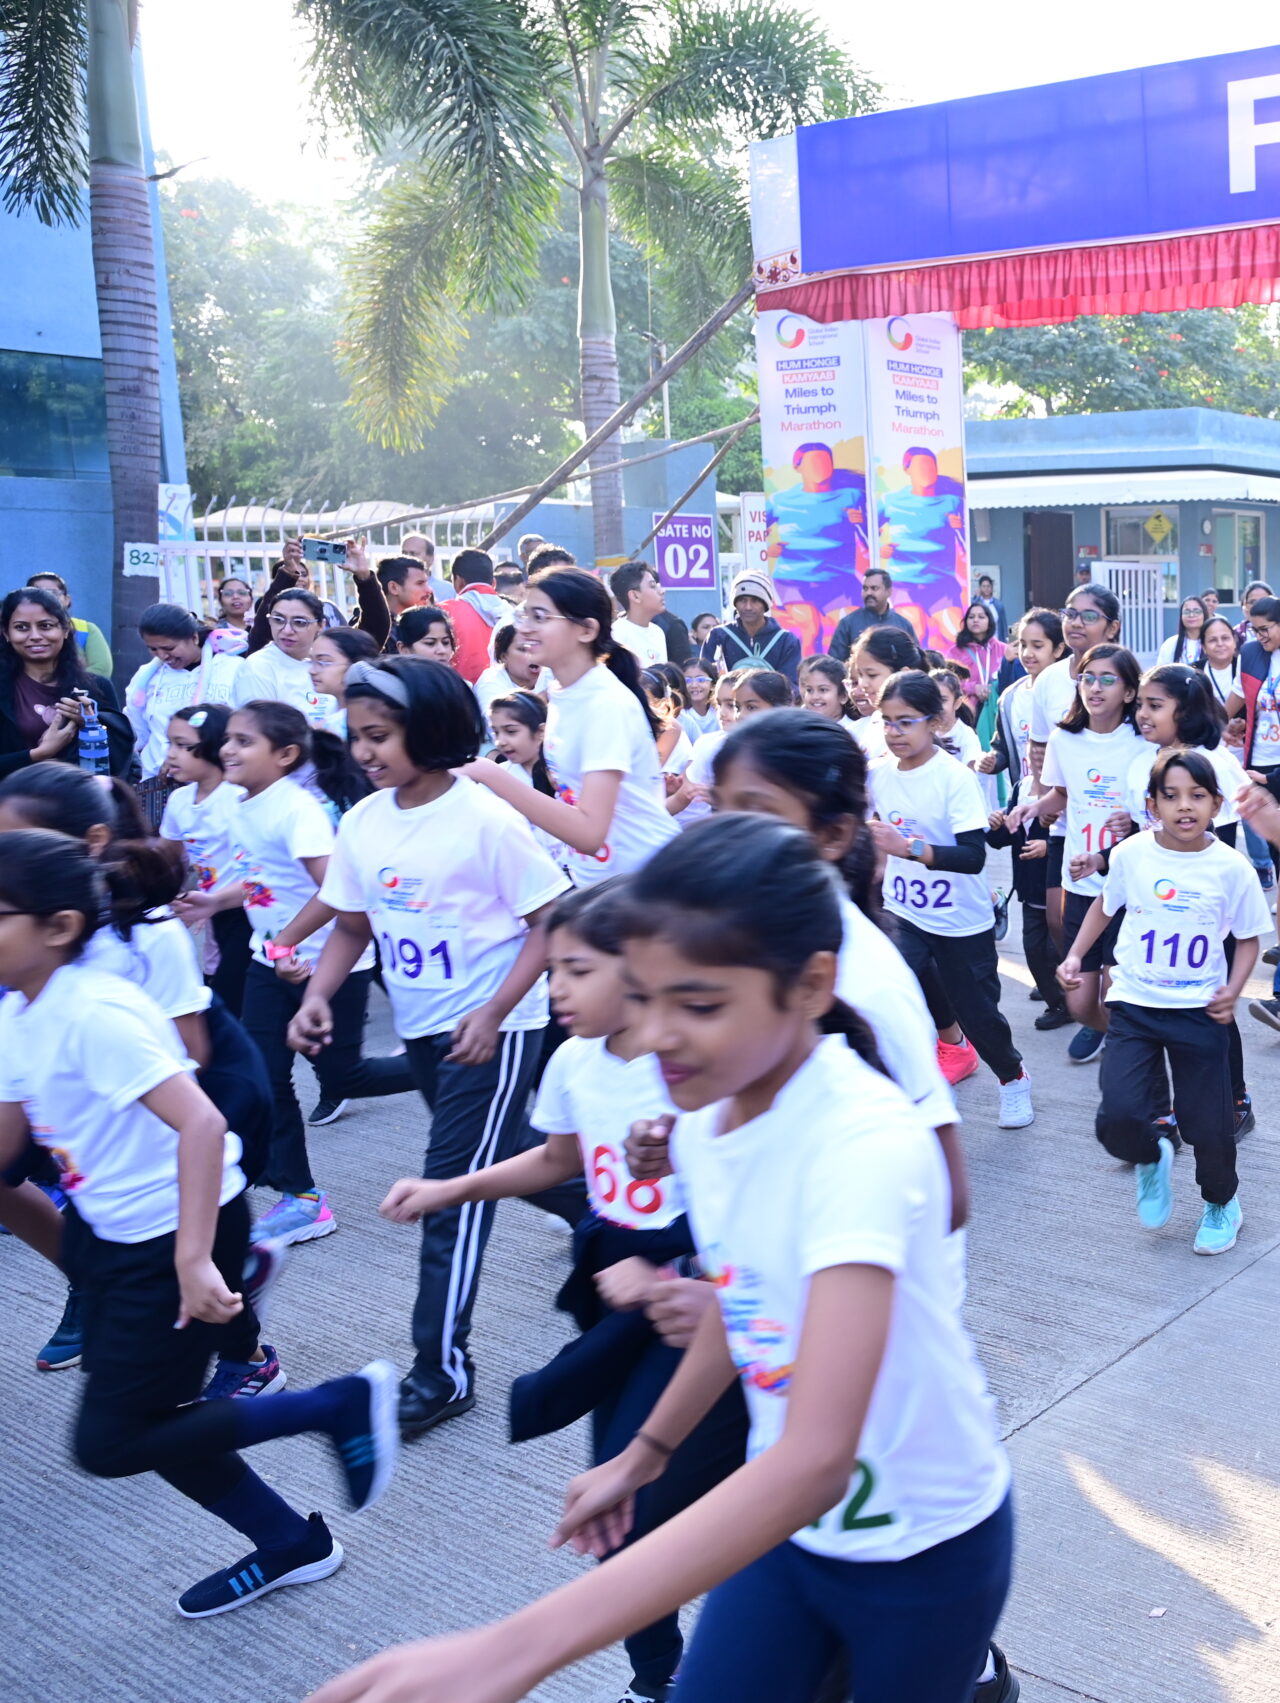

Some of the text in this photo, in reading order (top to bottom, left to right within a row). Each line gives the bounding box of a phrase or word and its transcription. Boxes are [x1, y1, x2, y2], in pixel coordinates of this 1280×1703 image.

[778, 358, 839, 370] HUM HONGE
[888, 360, 940, 377] HUM HONGE
[784, 371, 833, 383] KAMYAAB
[785, 386, 834, 398] Miles to
[895, 389, 938, 404] Miles to
[784, 402, 836, 415] Triumph
[894, 405, 940, 421] Triumph
[780, 420, 842, 432] Marathon
[891, 421, 945, 437] Marathon
[692, 525, 711, 538] NO
[664, 543, 710, 579] 02
[894, 876, 953, 909] 032
[1140, 929, 1209, 969] 110
